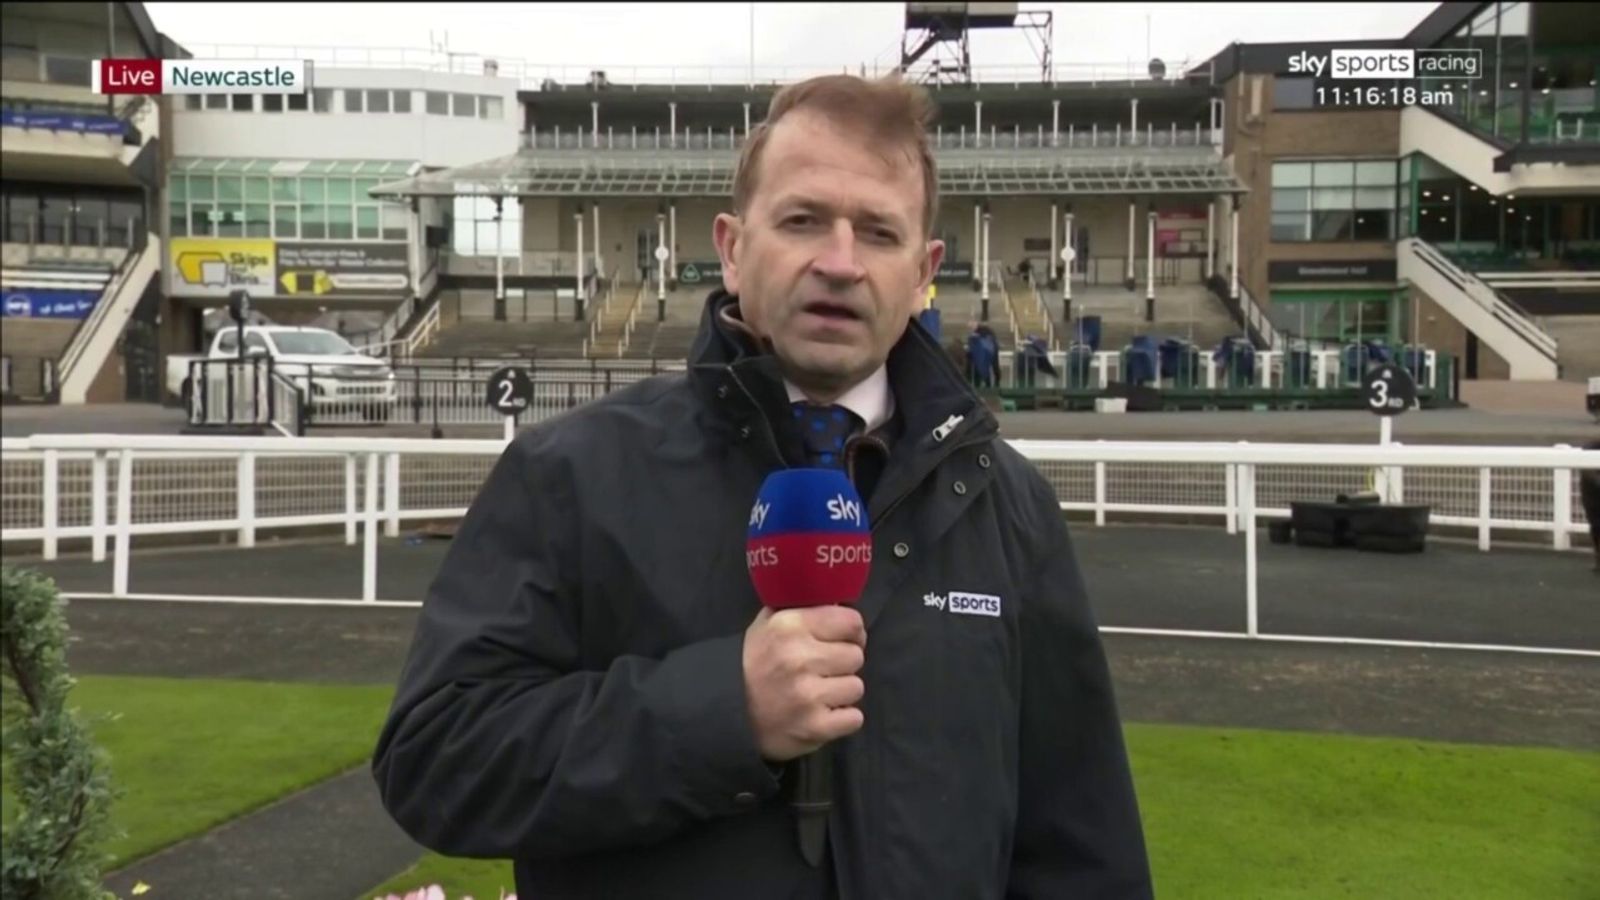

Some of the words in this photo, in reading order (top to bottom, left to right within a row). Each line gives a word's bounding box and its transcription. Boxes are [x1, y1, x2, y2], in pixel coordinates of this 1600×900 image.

[826, 493, 861, 527] sky
[816, 541, 872, 568] sports
[923, 591, 948, 611] sky
[951, 596, 999, 613] sports
